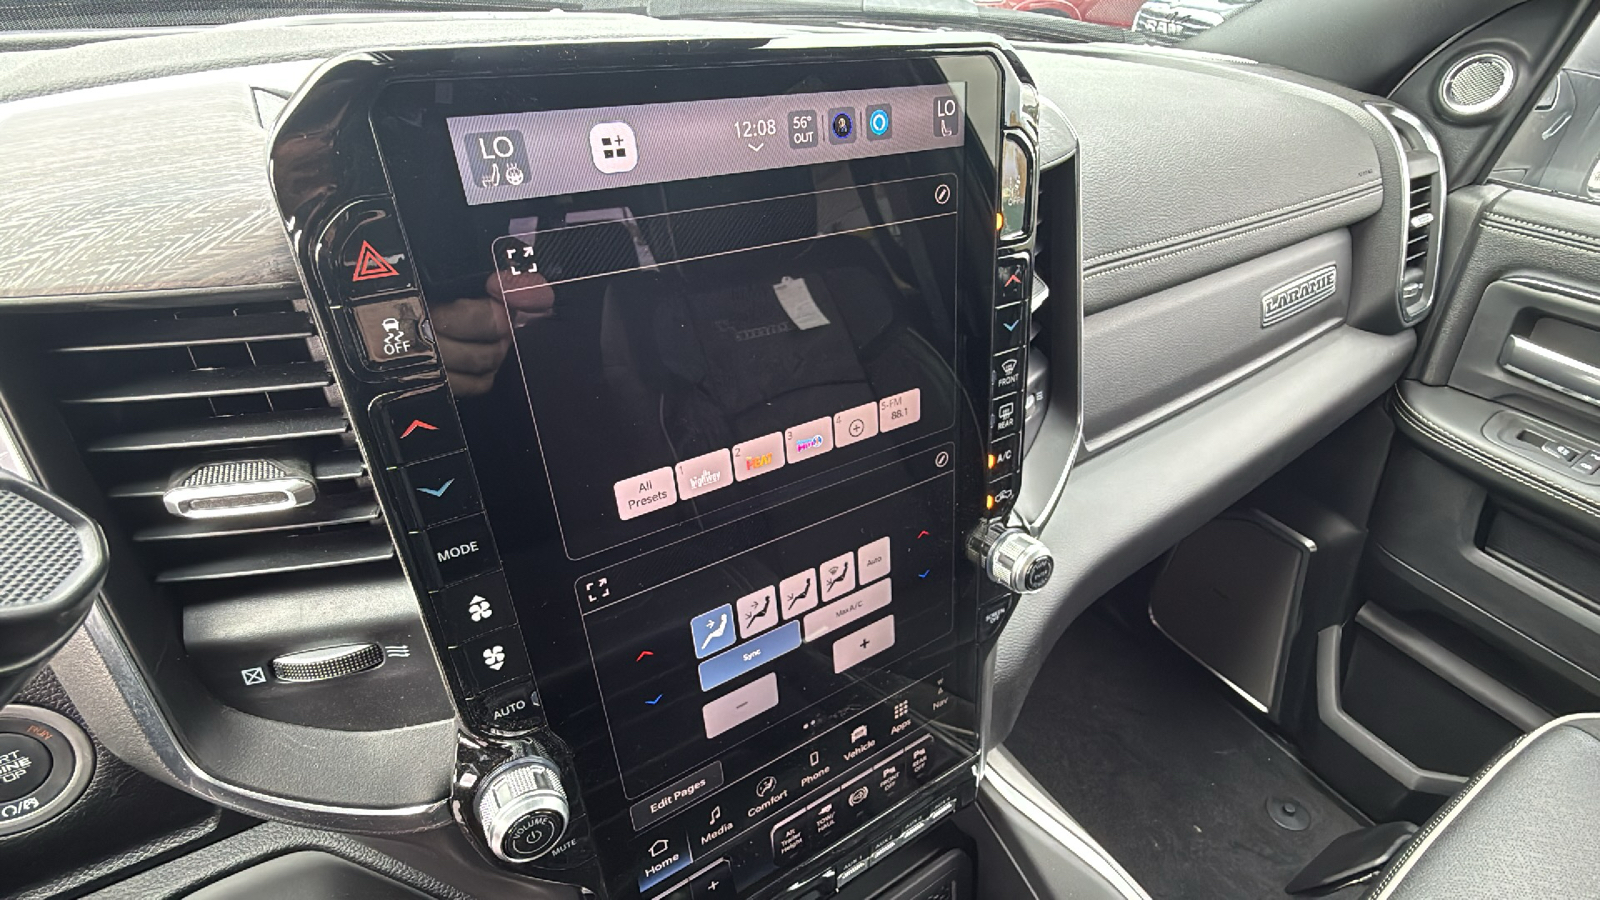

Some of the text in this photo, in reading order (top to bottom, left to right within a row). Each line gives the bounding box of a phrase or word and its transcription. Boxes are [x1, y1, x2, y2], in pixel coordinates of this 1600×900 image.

[937, 99, 956, 117] LO
[734, 119, 776, 139] 12:08
[793, 116, 812, 129] 56°
[793, 131, 814, 144] OUT
[479, 136, 514, 160] LO
[1265, 273, 1335, 314] LARAMIE
[383, 340, 412, 356] OFF
[998, 373, 1019, 387] FRONT
[881, 397, 903, 411] 5-FM
[836, 415, 842, 425] 4
[891, 408, 909, 420] 88.1
[997, 417, 1014, 430] REAR
[787, 431, 793, 440] 3
[735, 447, 741, 457] 2
[997, 449, 1011, 463] A/C
[746, 452, 773, 471] HEAT
[638, 479, 653, 493] All
[628, 490, 668, 510] Presets
[437, 540, 480, 563] MODE
[867, 556, 882, 567] Auto
[836, 600, 864, 618] Max A/C
[743, 648, 761, 661] Sync
[493, 699, 526, 720] AUTO
[933, 697, 949, 711] Nav
[27, 725, 53, 741] RUN
[890, 718, 912, 736] Apps
[843, 737, 876, 762] Vehicle
[801, 765, 830, 788] Phone
[649, 778, 706, 814] Edit Pages
[747, 789, 788, 818] Comfort
[513, 817, 549, 839] VOLUME
[701, 821, 733, 846] Media
[551, 838, 577, 857] MUTE
[644, 853, 680, 878] Home
